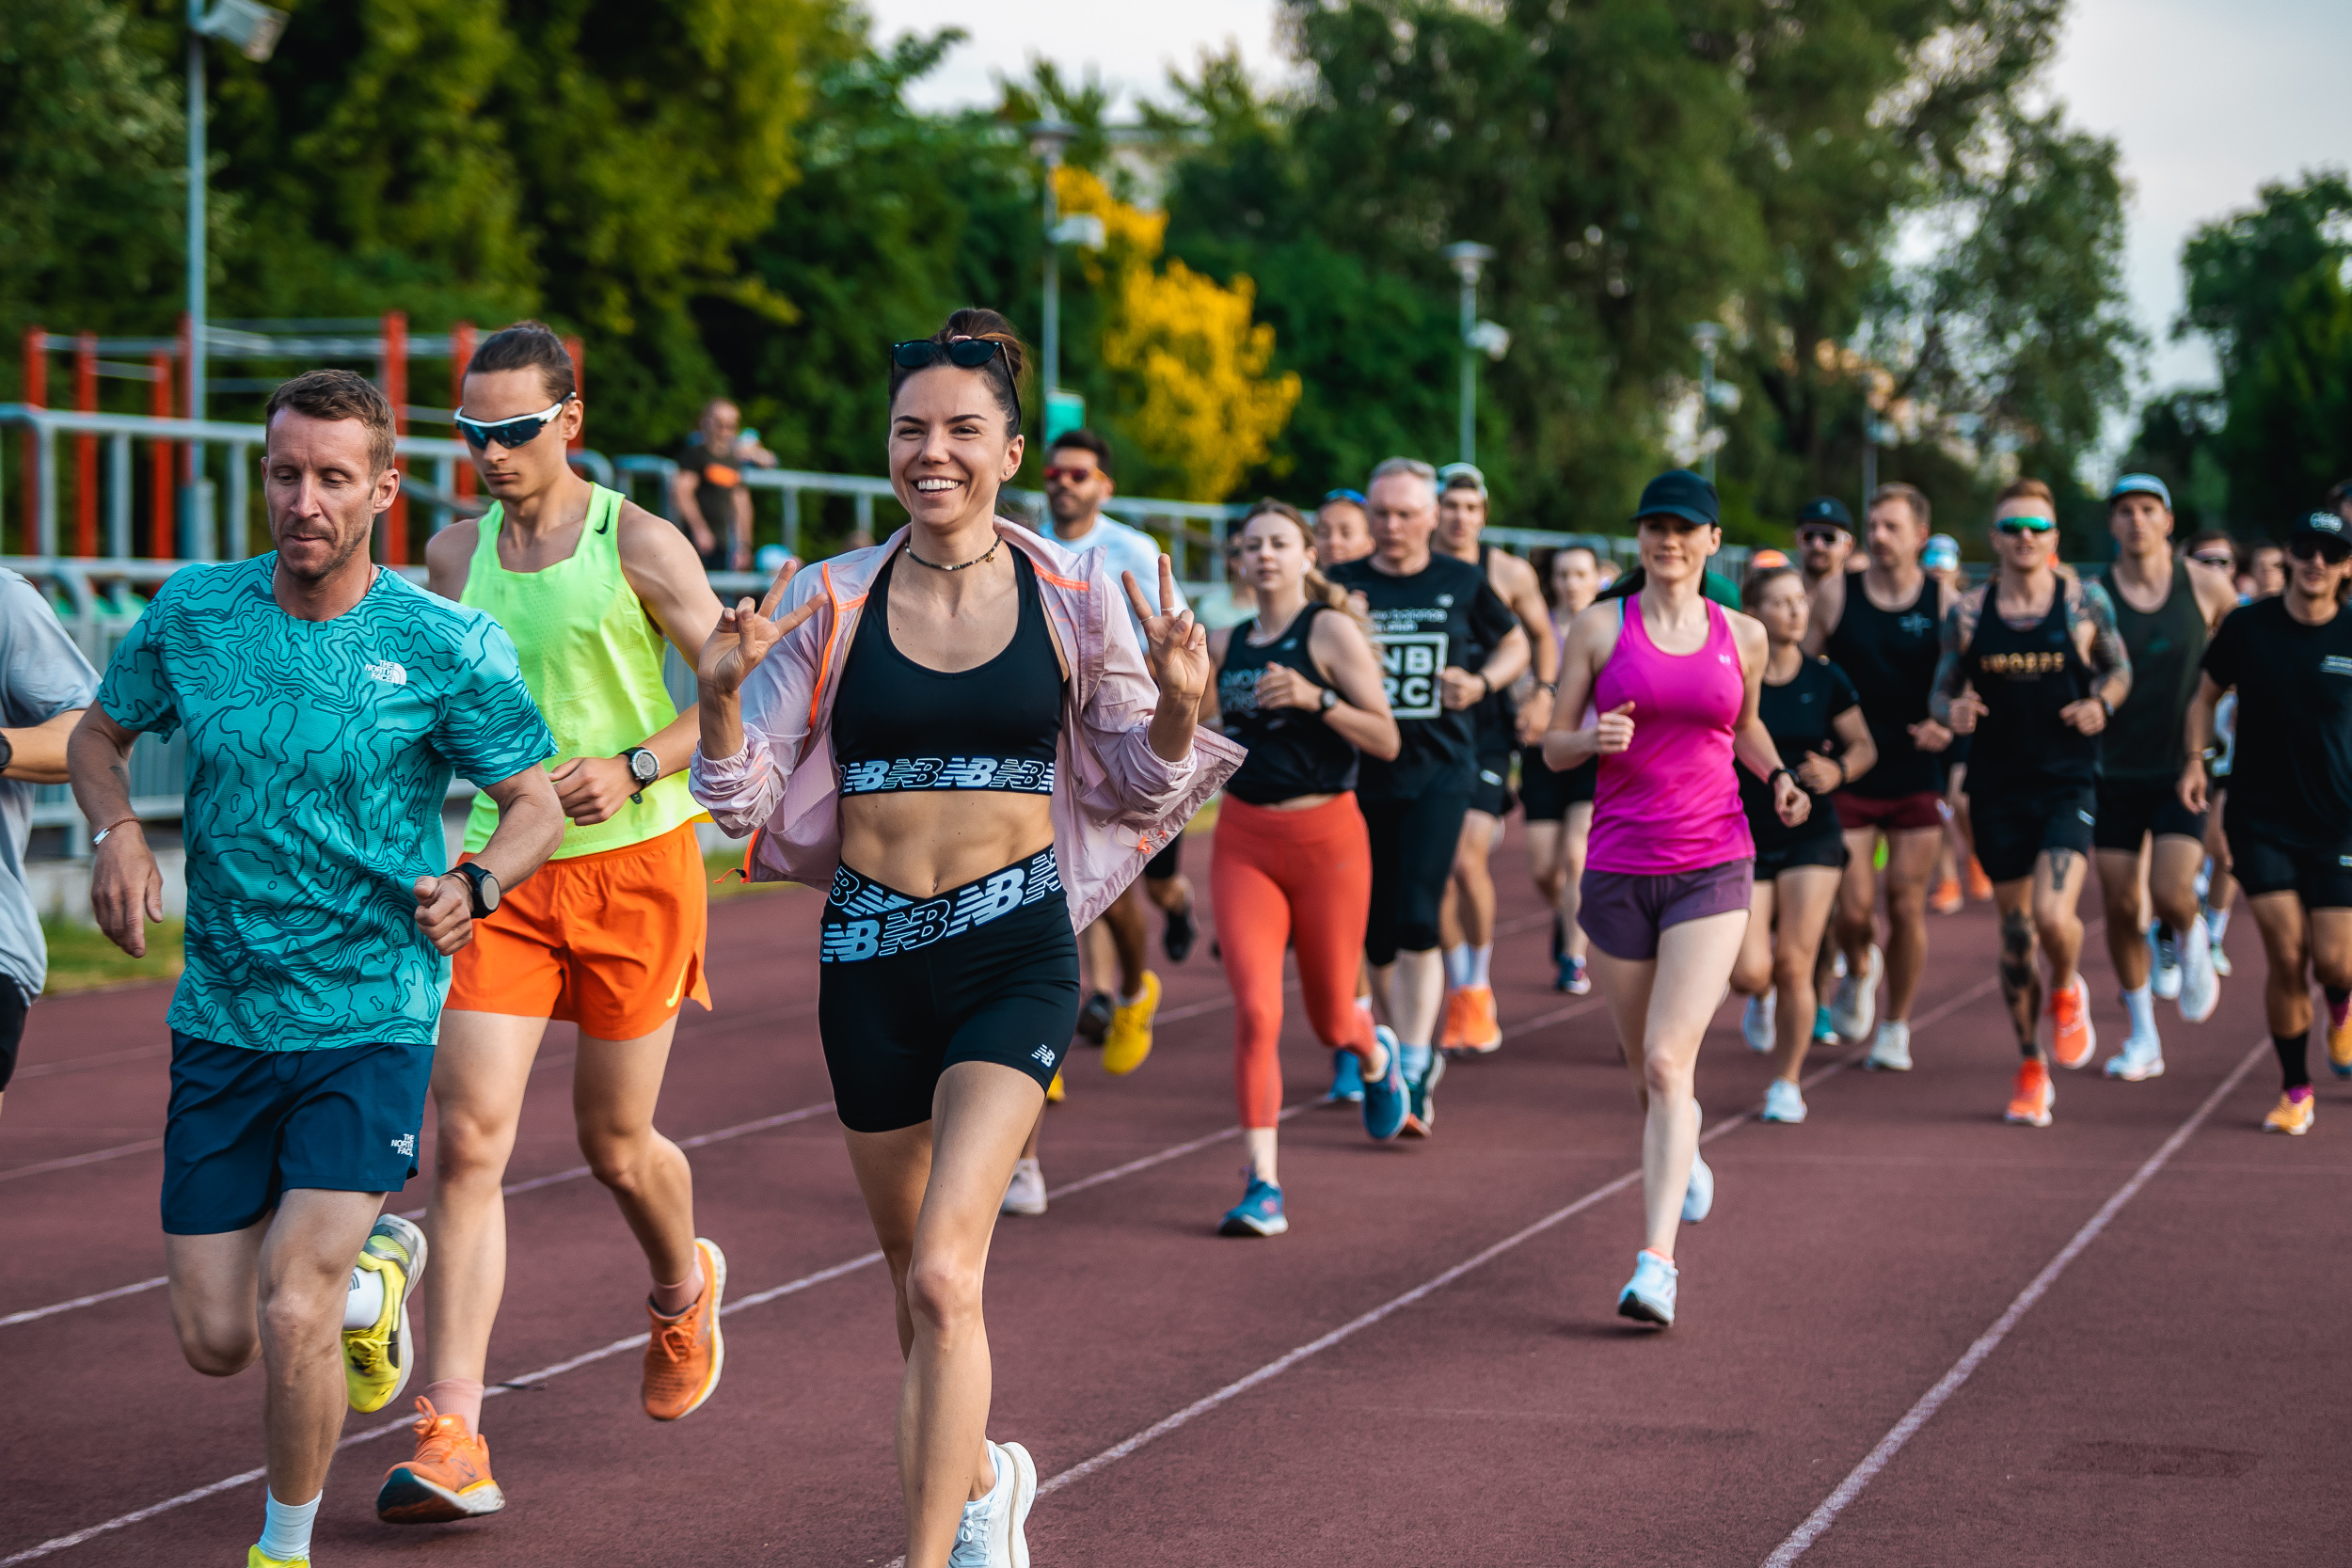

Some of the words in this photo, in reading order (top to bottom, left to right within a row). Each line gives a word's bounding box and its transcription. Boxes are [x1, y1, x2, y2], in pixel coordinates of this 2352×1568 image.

[379, 659, 394, 669] THE
[1380, 645, 1434, 676] NB
[364, 663, 392, 675] NORTH
[371, 672, 392, 683] FACE
[844, 761, 890, 792] NB
[882, 757, 944, 789] NB
[934, 757, 998, 787] NB
[989, 758, 1045, 790] NB
[822, 919, 881, 962] NB
[879, 899, 950, 957] NB
[946, 867, 1025, 937] NB
[403, 1133, 415, 1142] THE
[390, 1139, 414, 1148] NORTH
